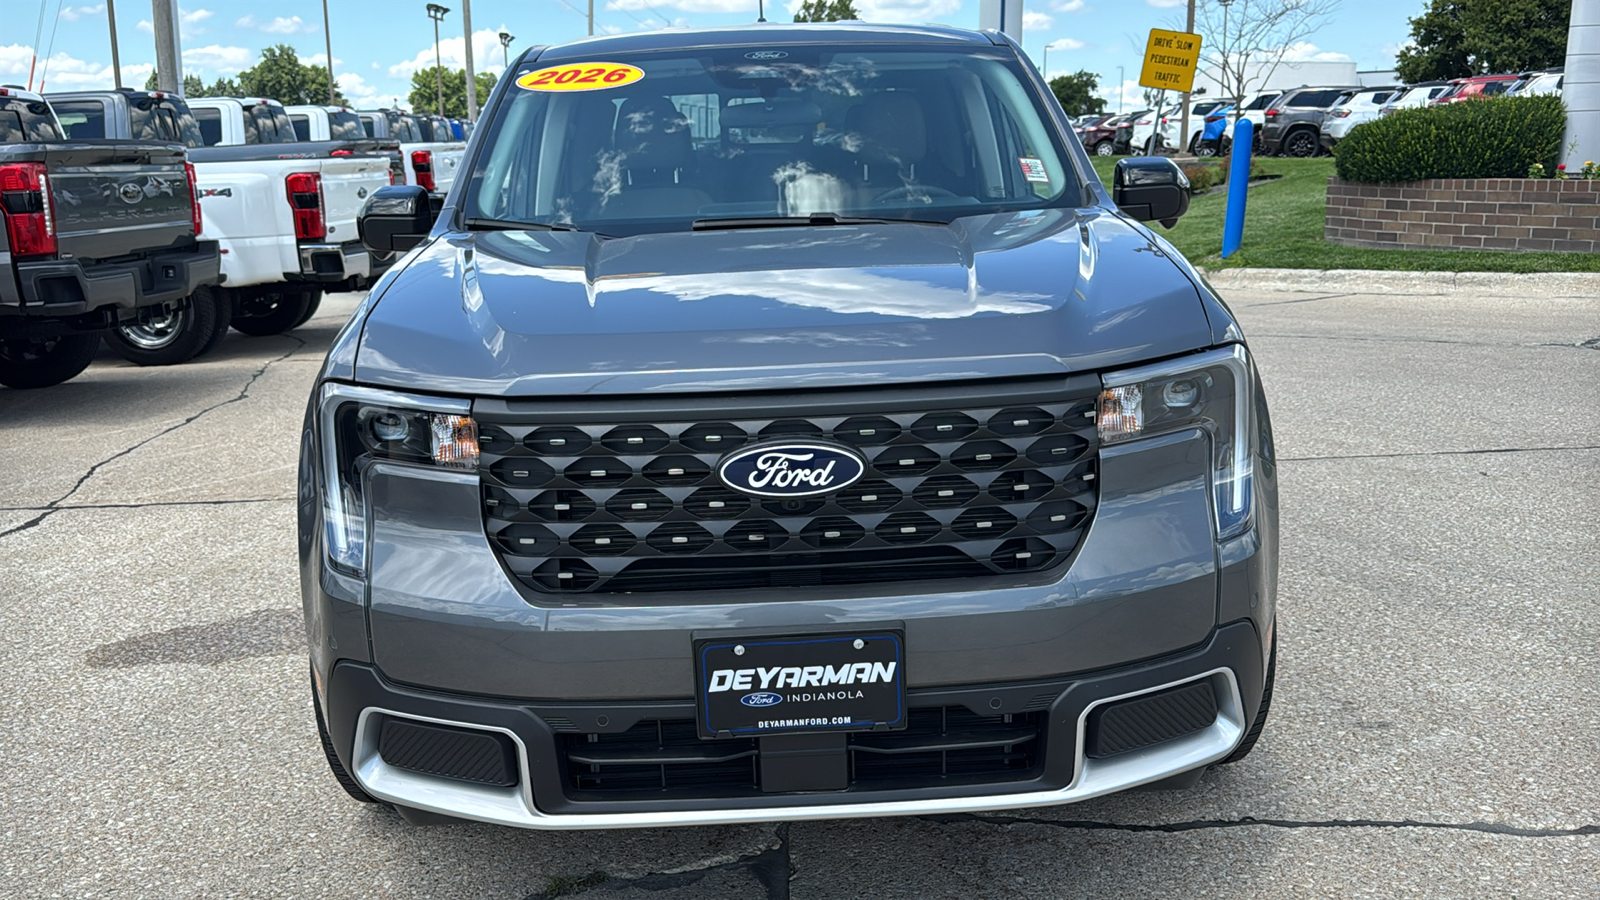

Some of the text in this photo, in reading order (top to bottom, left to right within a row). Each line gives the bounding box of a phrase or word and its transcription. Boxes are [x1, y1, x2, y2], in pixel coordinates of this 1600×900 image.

[1154, 37, 1193, 50] DRIVE SLOW
[1150, 53, 1190, 67] PEDESTRIAN
[527, 68, 632, 86] 2026
[1154, 71, 1181, 83] TRAFFIC
[748, 453, 837, 488] Ford
[708, 661, 897, 693] DEYARMAN
[748, 690, 864, 705] Ford INDIANOLA
[758, 716, 851, 729] DEYARMANFORD.COM
